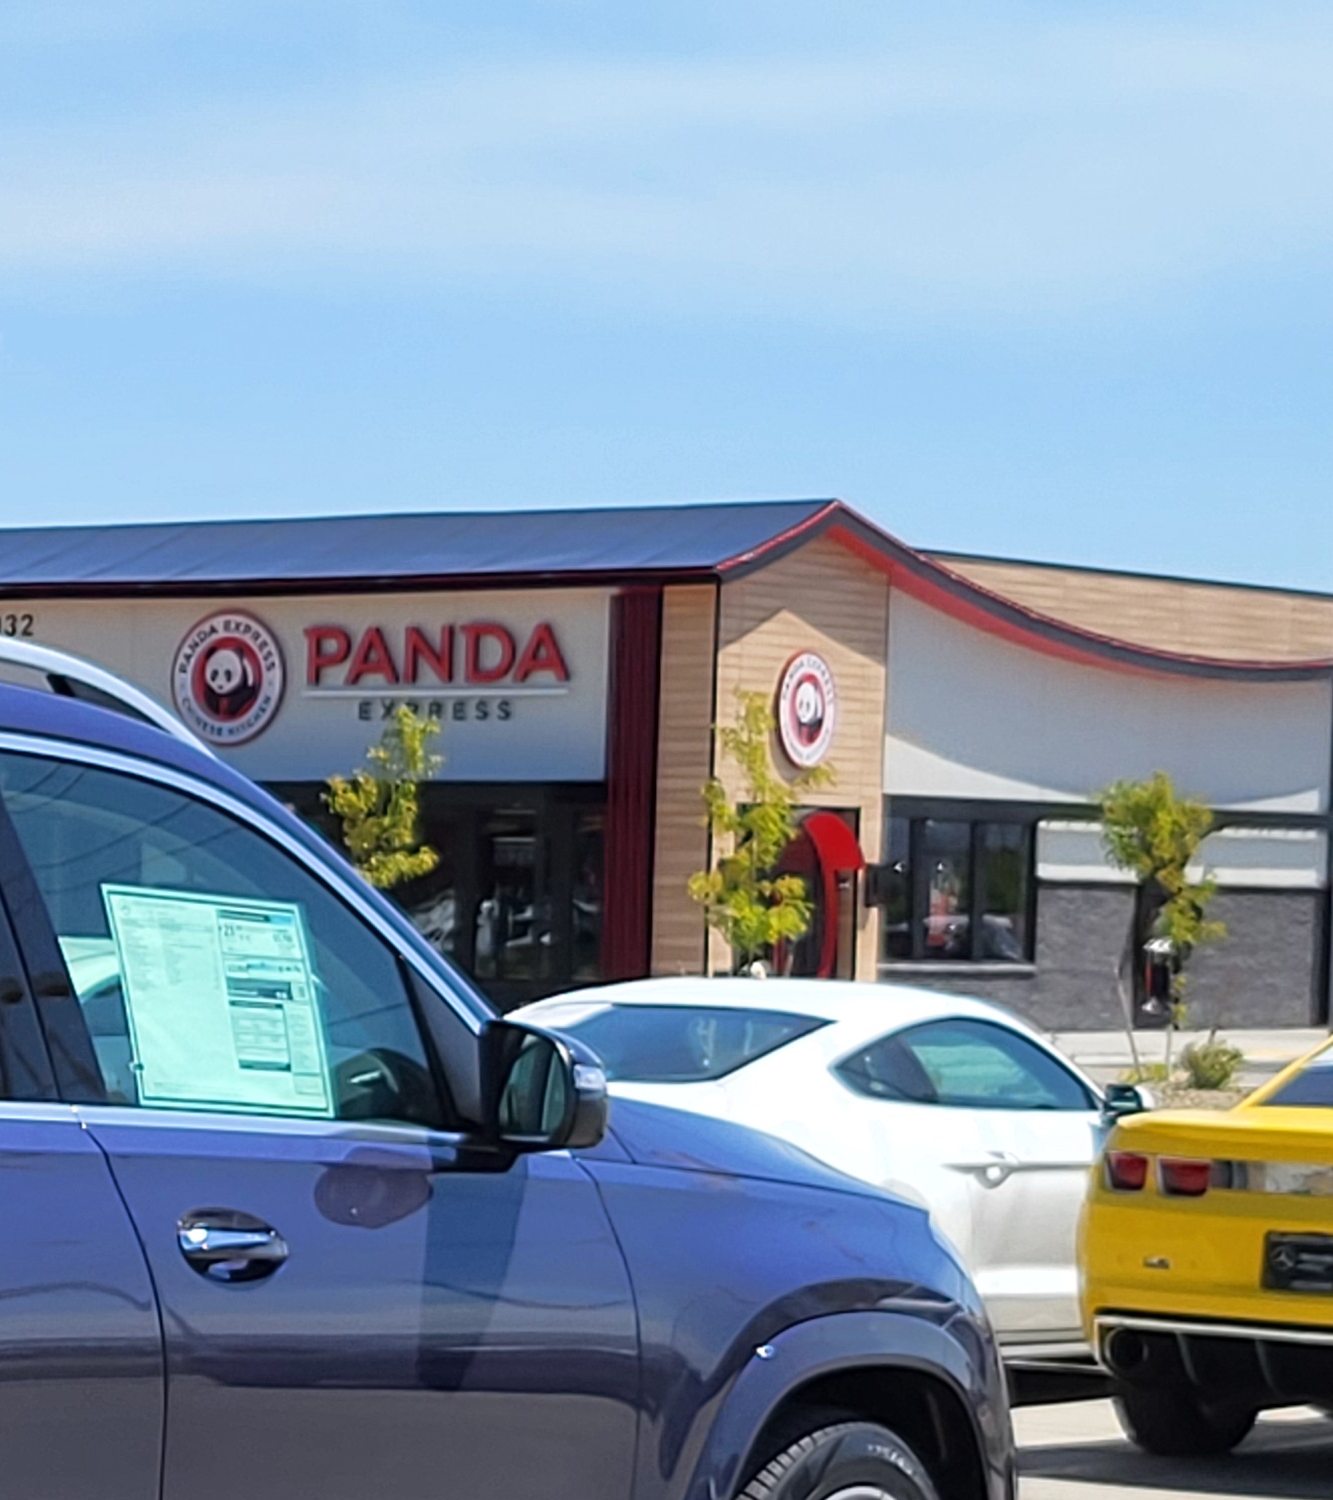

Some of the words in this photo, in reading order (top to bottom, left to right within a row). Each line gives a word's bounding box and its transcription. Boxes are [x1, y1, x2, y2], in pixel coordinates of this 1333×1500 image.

[178, 623, 219, 674] PANDA
[223, 619, 276, 672] EXPRESS
[303, 622, 571, 686] PANDA
[181, 697, 224, 737] CHNESE
[358, 700, 513, 722] EXPRESS
